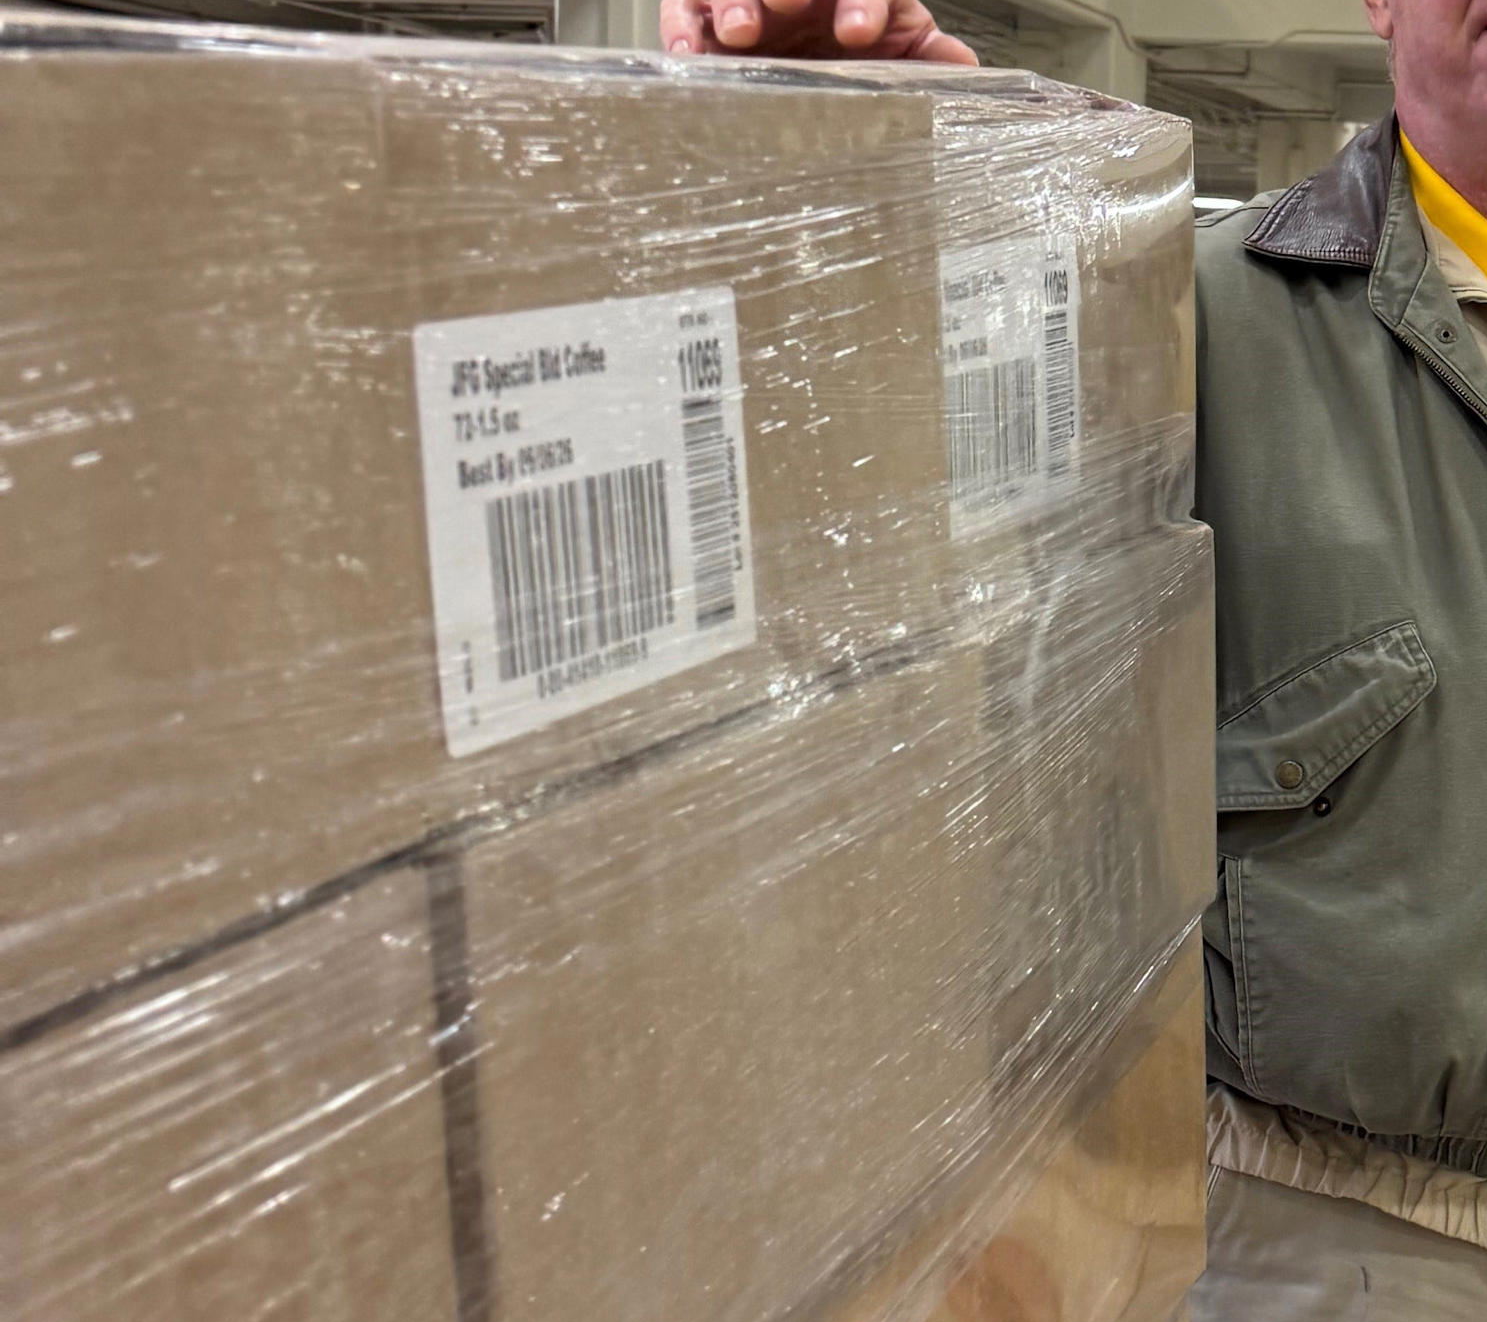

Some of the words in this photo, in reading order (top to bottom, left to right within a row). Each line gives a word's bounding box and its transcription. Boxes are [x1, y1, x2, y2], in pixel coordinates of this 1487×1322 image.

[483, 350, 535, 398] Special
[564, 341, 606, 378] Coffee
[457, 455, 494, 489] Best
[495, 452, 514, 484] By
